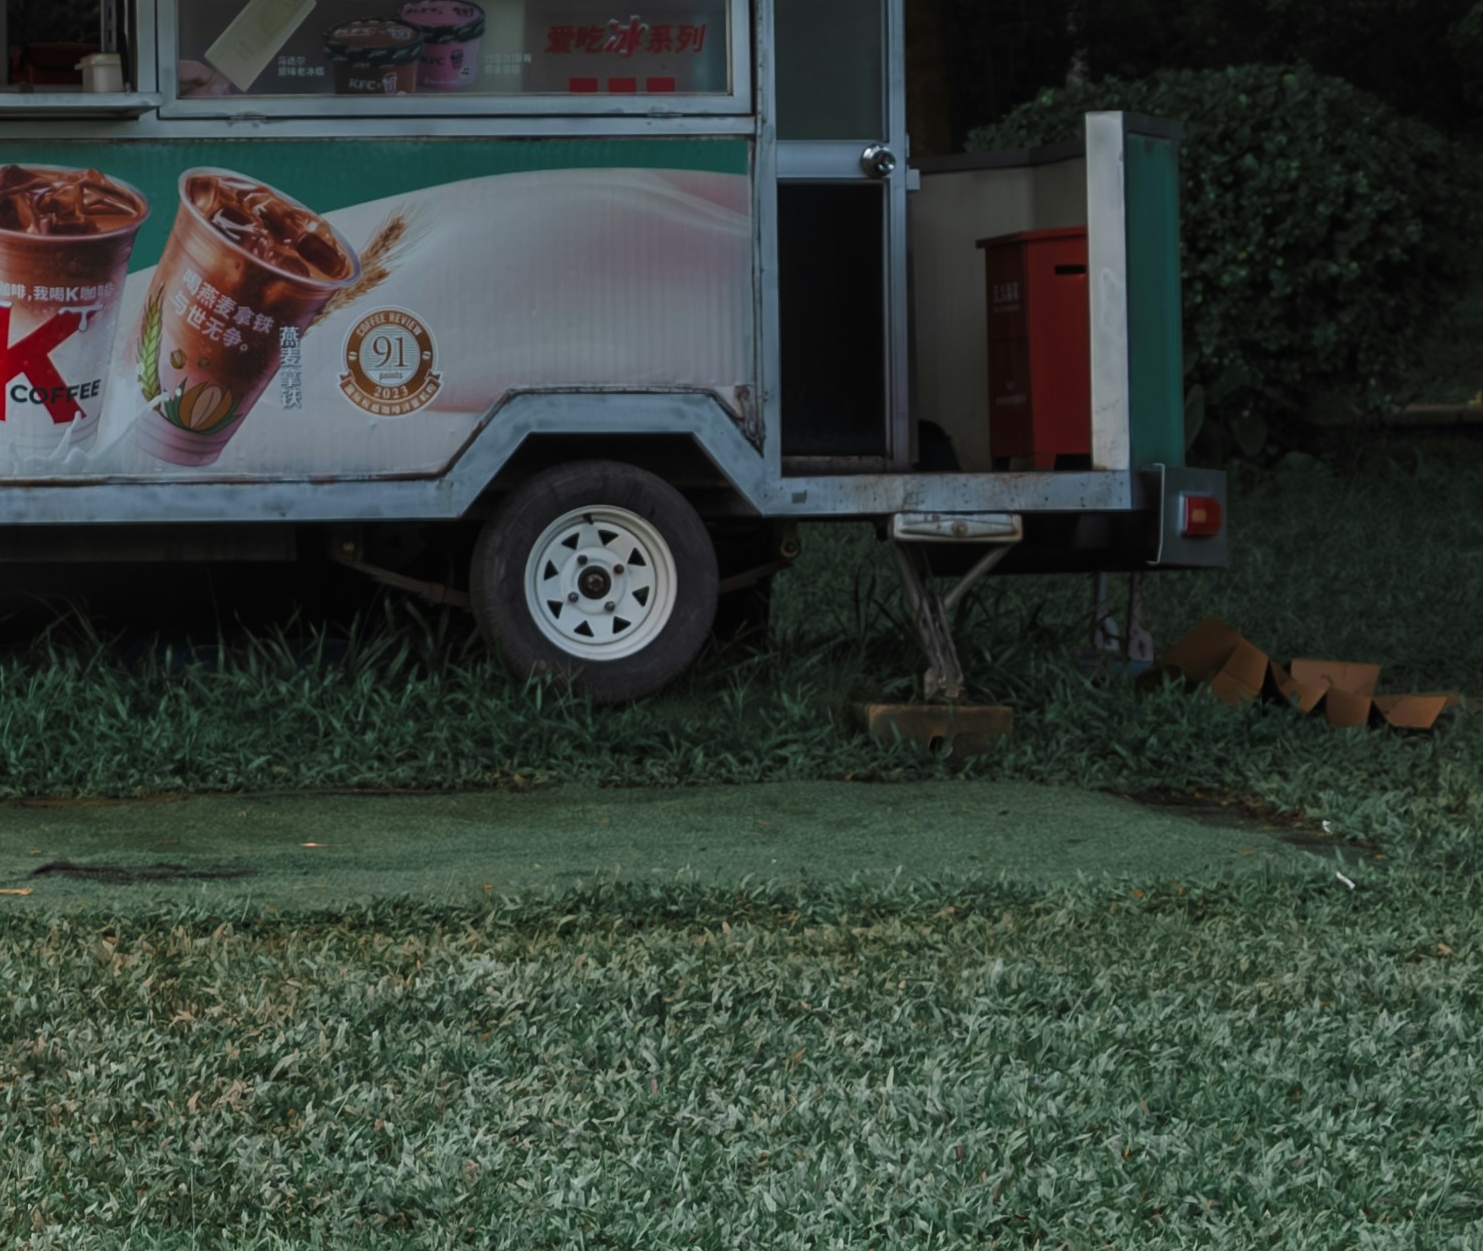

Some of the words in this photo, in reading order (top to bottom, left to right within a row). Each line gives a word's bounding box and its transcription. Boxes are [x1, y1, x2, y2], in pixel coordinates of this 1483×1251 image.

[546, 14, 707, 59] 爱吃冰系列
[348, 77, 376, 90] KFC
[182, 268, 275, 335] 喝燕麦拿铁
[171, 290, 249, 353] 与世无争。
[356, 313, 386, 337] COFFEE
[389, 312, 423, 336] REVIEW
[373, 335, 408, 368] 91
[10, 379, 102, 405] COFFEE
[374, 386, 409, 399] 2023
